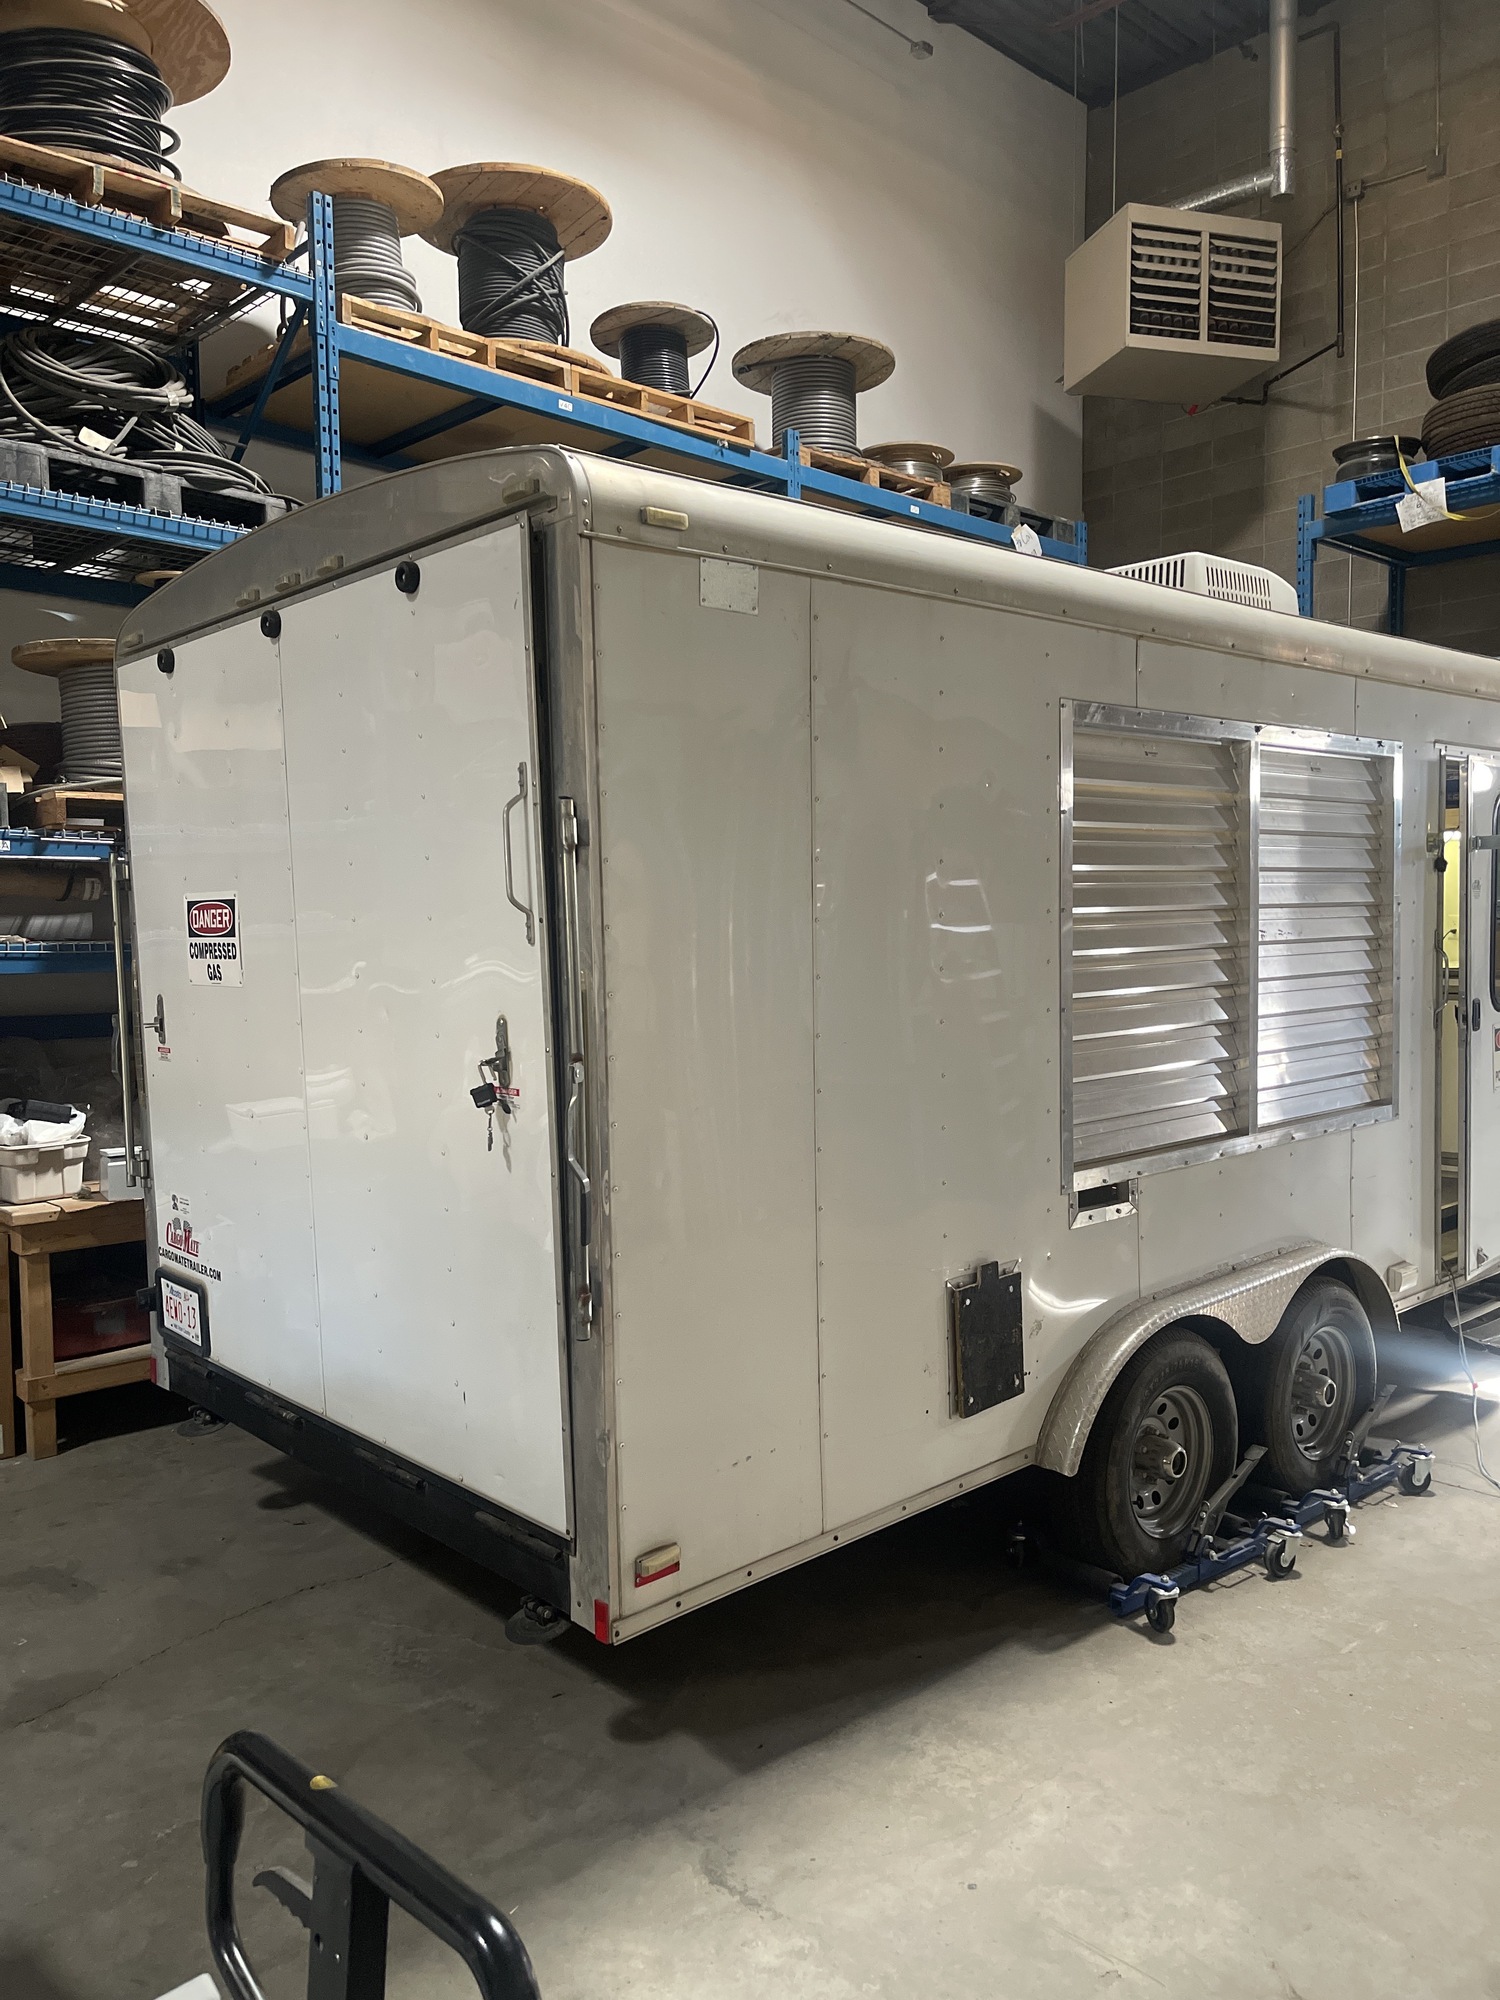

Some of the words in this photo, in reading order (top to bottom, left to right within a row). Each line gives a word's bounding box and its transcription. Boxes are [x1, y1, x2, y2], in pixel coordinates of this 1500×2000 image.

[192, 909, 230, 928] DANGER
[189, 942, 237, 960] COMPRESSED
[207, 963, 222, 981] GAS
[158, 1246, 222, 1282] CARGOMATETRAILER.COM
